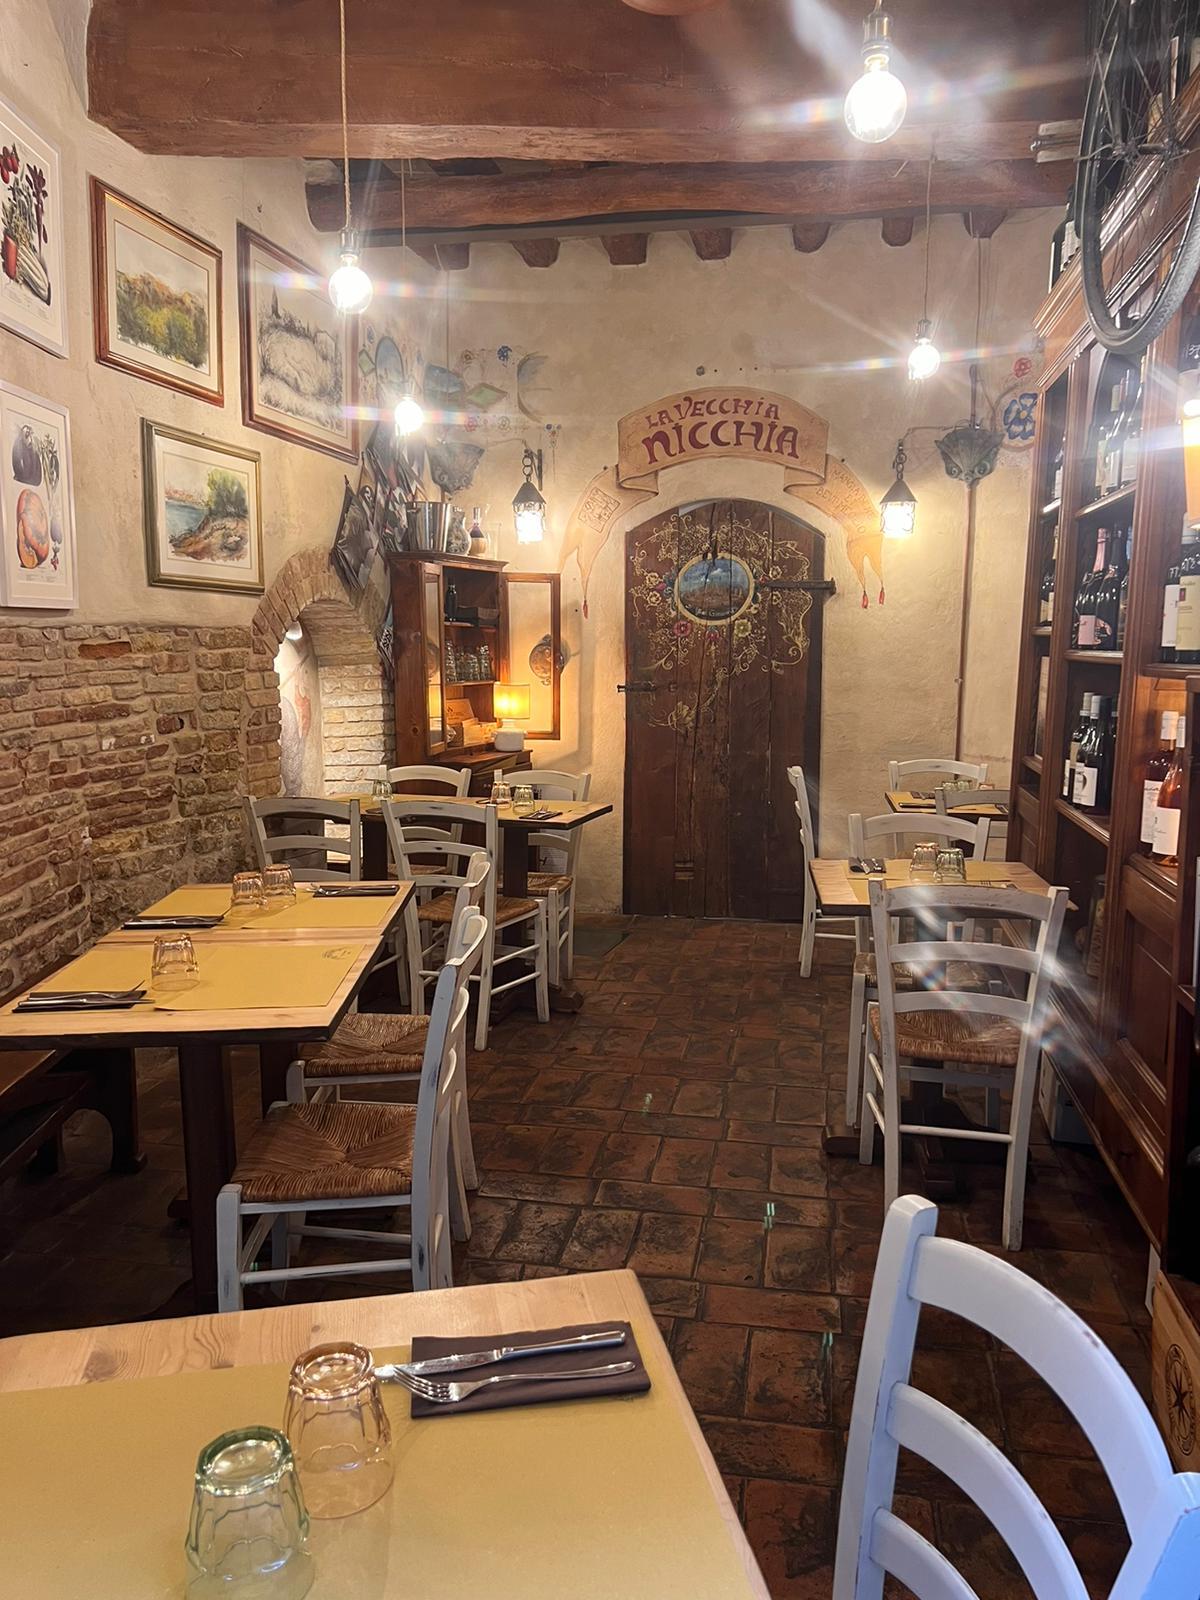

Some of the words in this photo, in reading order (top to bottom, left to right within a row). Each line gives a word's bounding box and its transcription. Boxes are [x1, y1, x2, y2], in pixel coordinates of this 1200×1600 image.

[644, 410, 674, 429] LA
[673, 396, 781, 421] VECCHIA
[641, 420, 800, 465] NICCHIA
